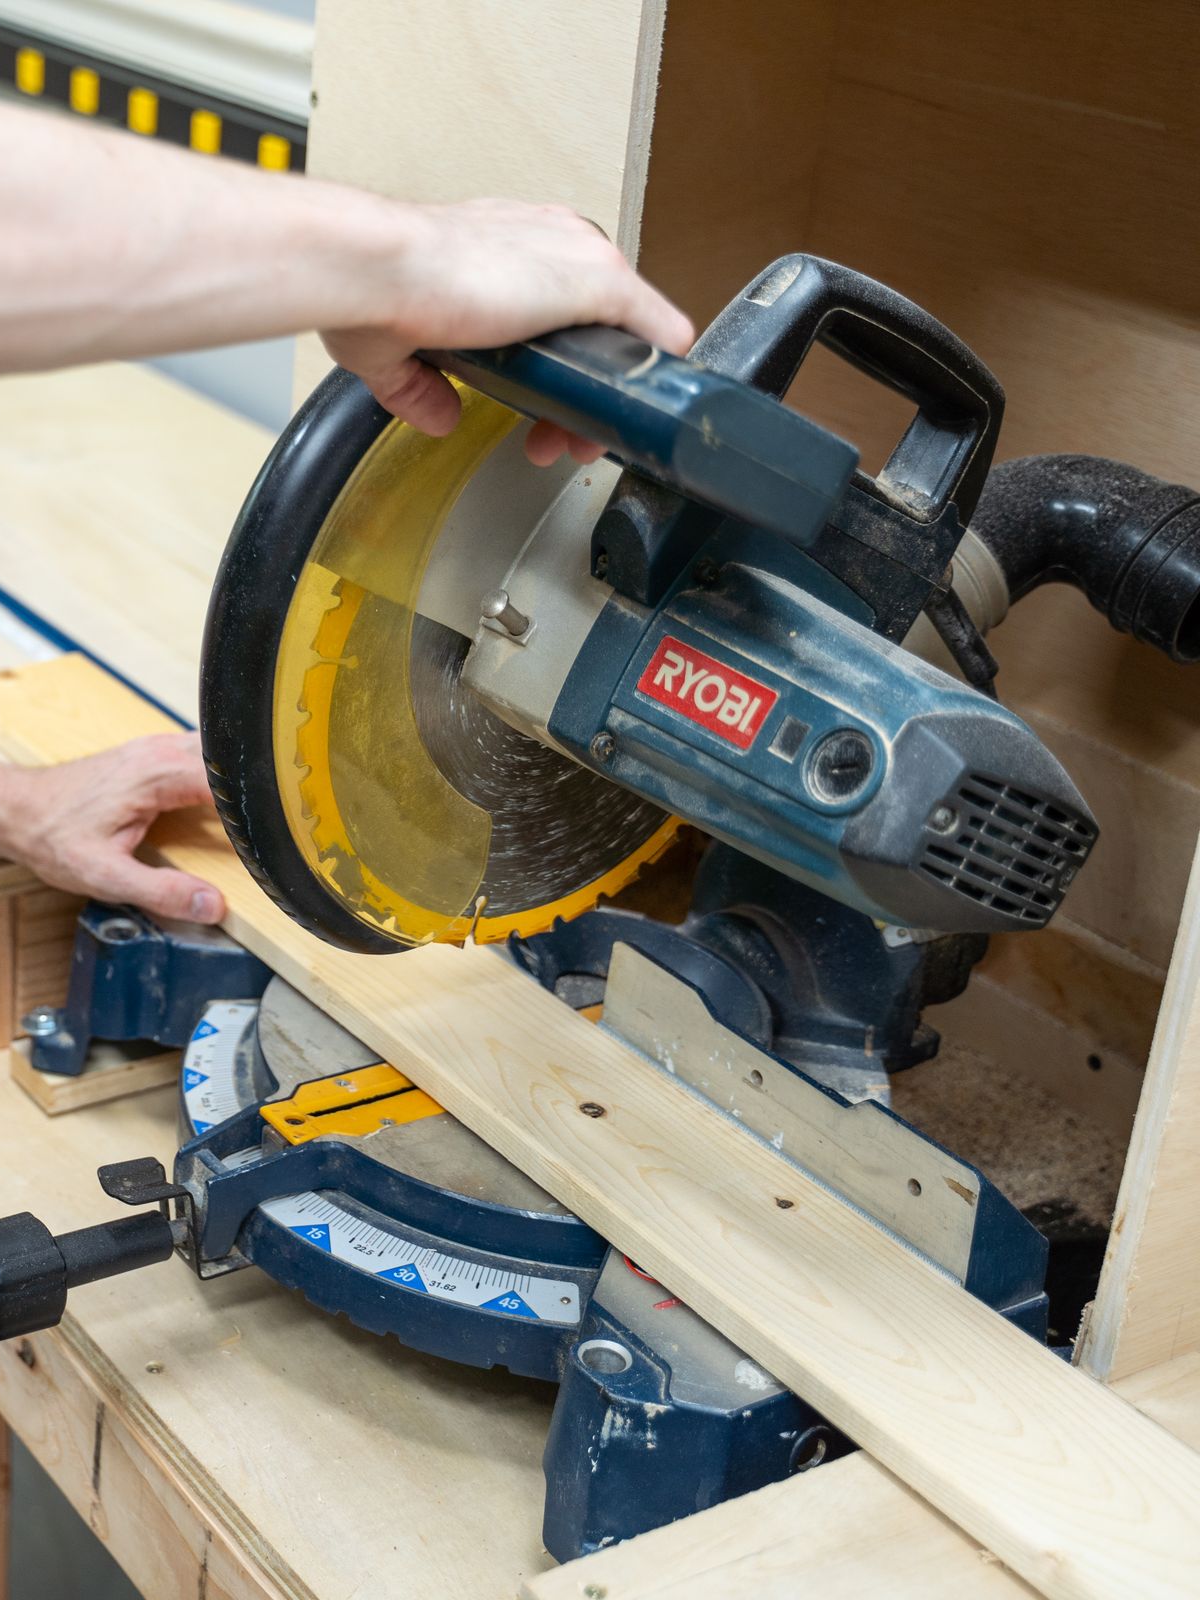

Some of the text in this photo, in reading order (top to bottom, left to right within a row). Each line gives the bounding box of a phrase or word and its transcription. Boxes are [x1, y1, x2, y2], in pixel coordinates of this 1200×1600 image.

[653, 649, 761, 733] RYOBI
[306, 1227, 327, 1239] 15
[353, 1243, 375, 1256] 22.5
[393, 1268, 417, 1282] 30
[428, 1280, 457, 1292] 31.62
[498, 1297, 521, 1310] 45
